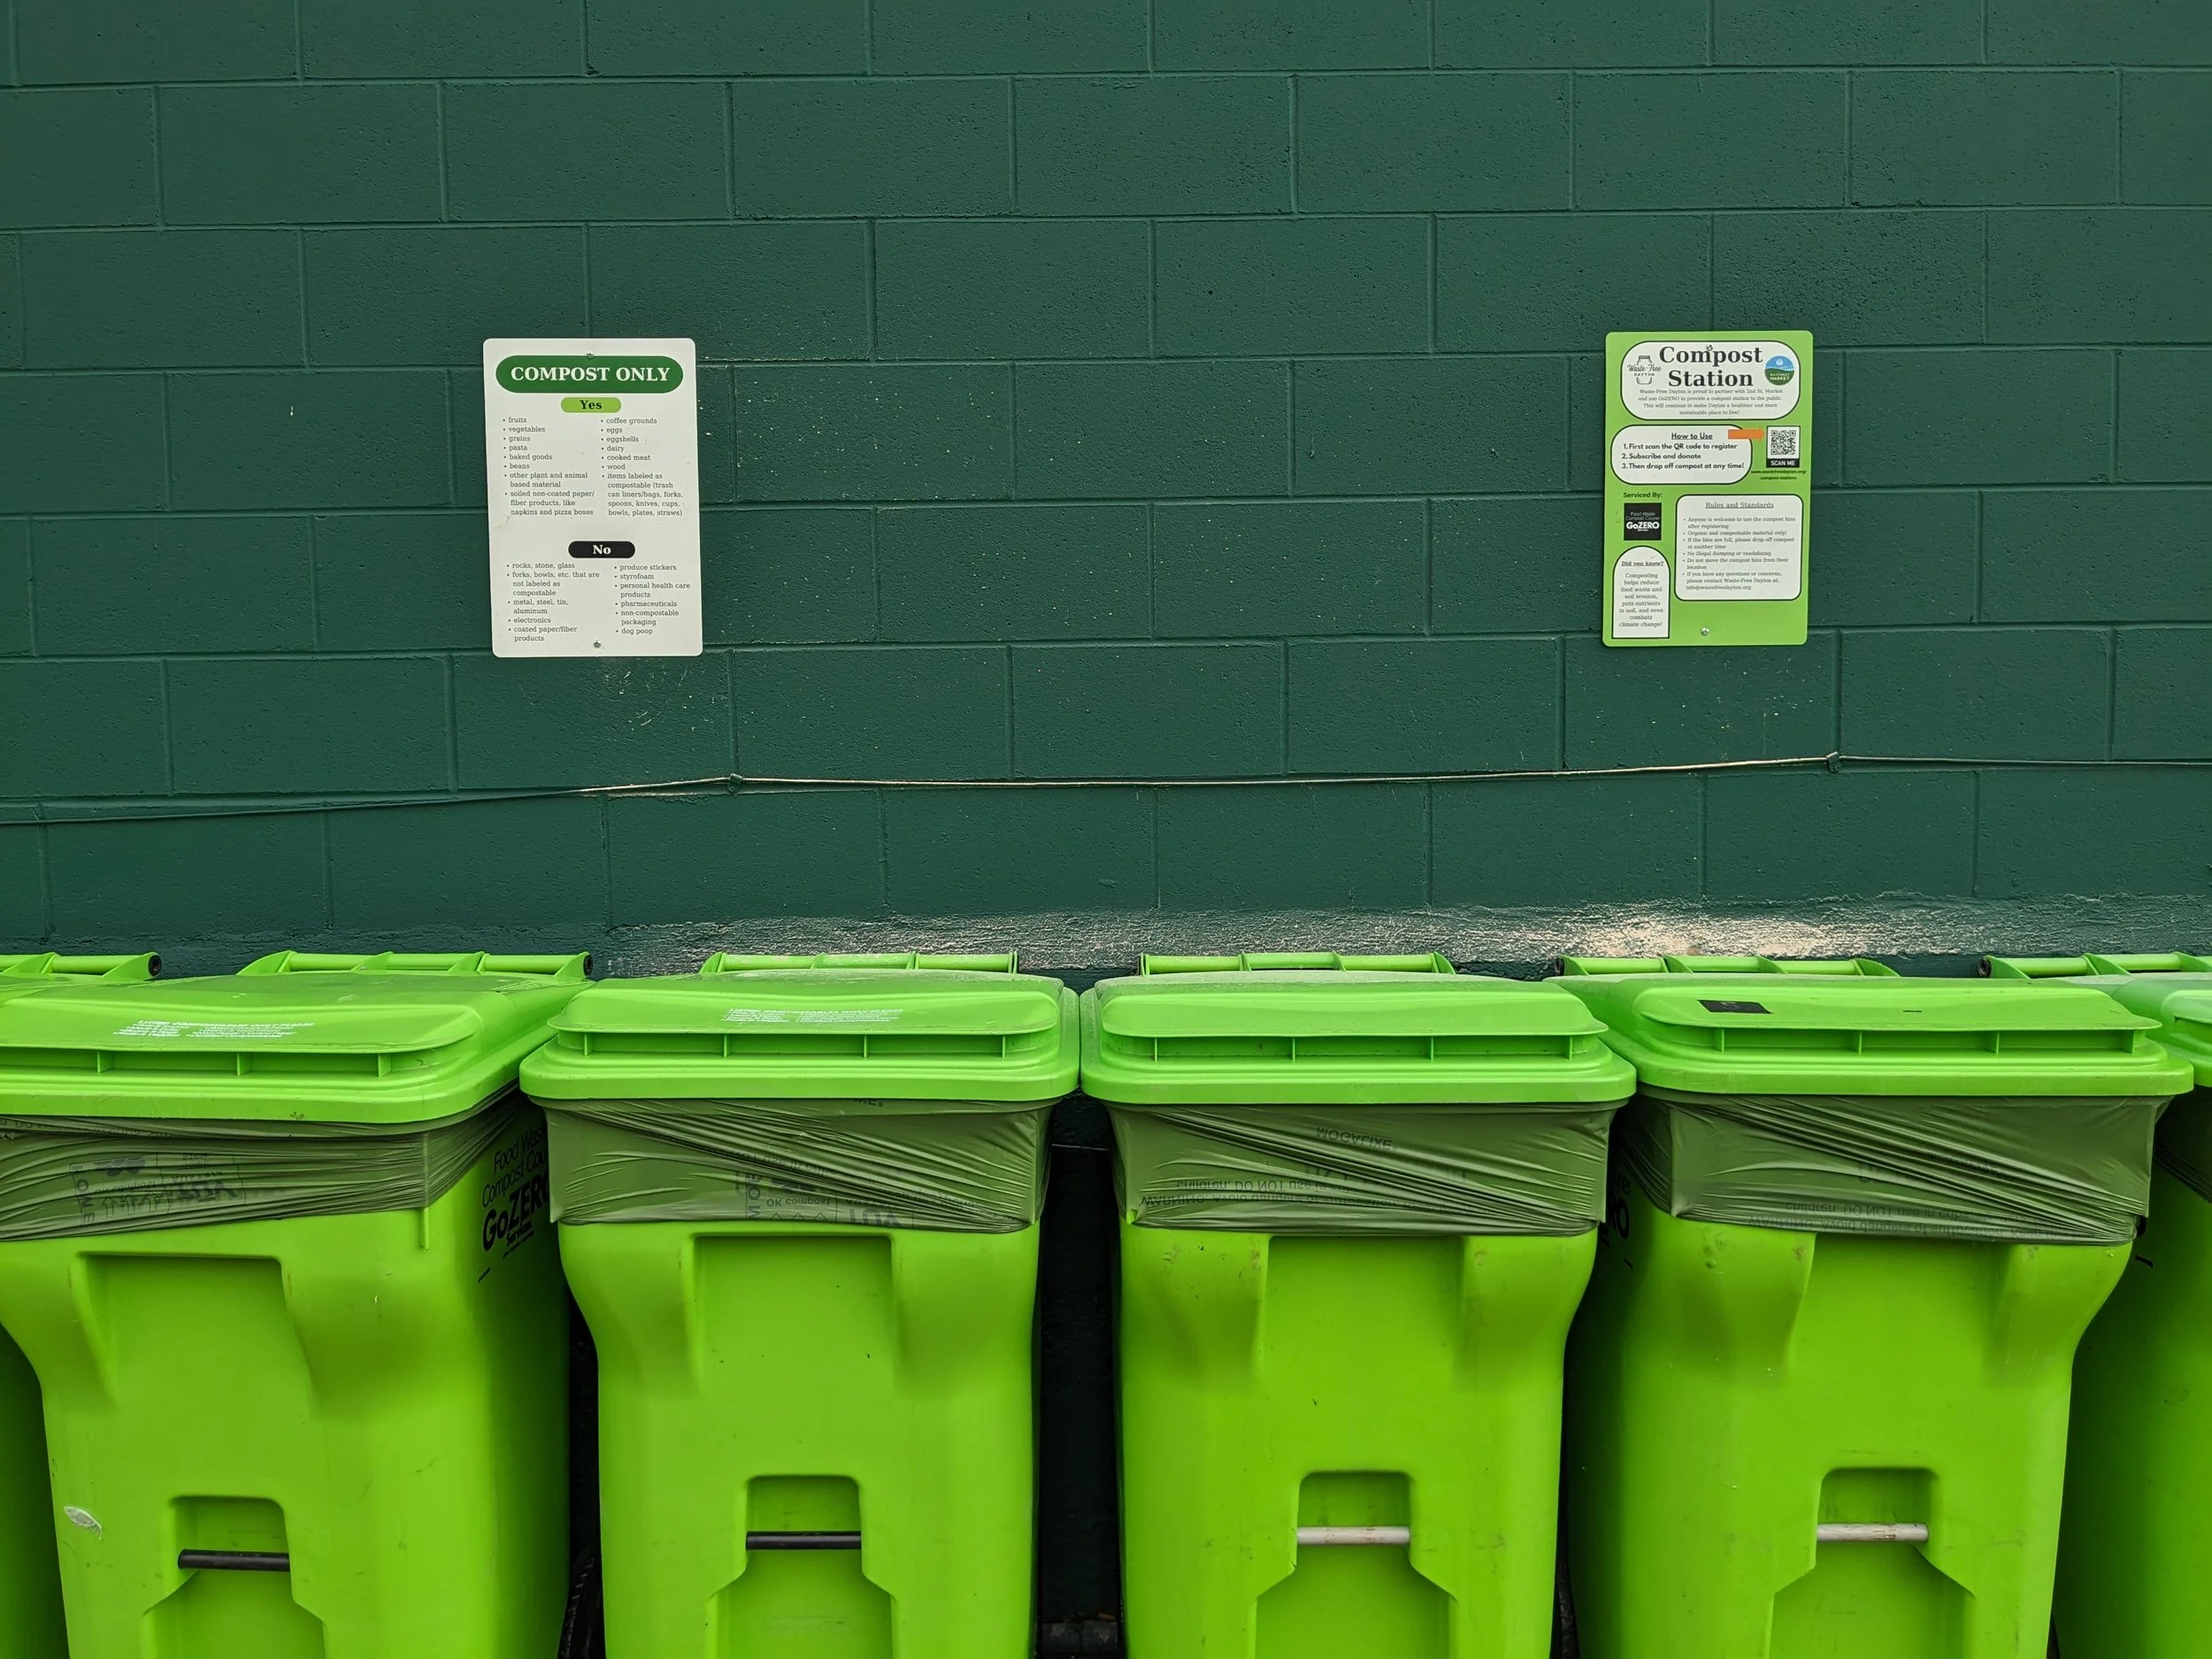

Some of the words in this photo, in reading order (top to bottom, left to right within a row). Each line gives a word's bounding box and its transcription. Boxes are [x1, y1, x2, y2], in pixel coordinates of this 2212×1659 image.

[1660, 346, 1763, 367] Compost
[511, 367, 610, 381] COMPOST
[616, 367, 670, 381] ONLY
[1669, 370, 1753, 387] Station
[580, 400, 602, 409] Yes
[1626, 522, 1659, 530] GoZERO
[593, 545, 611, 554] No
[495, 1138, 518, 1174] Food
[483, 1159, 524, 1208] Compost
